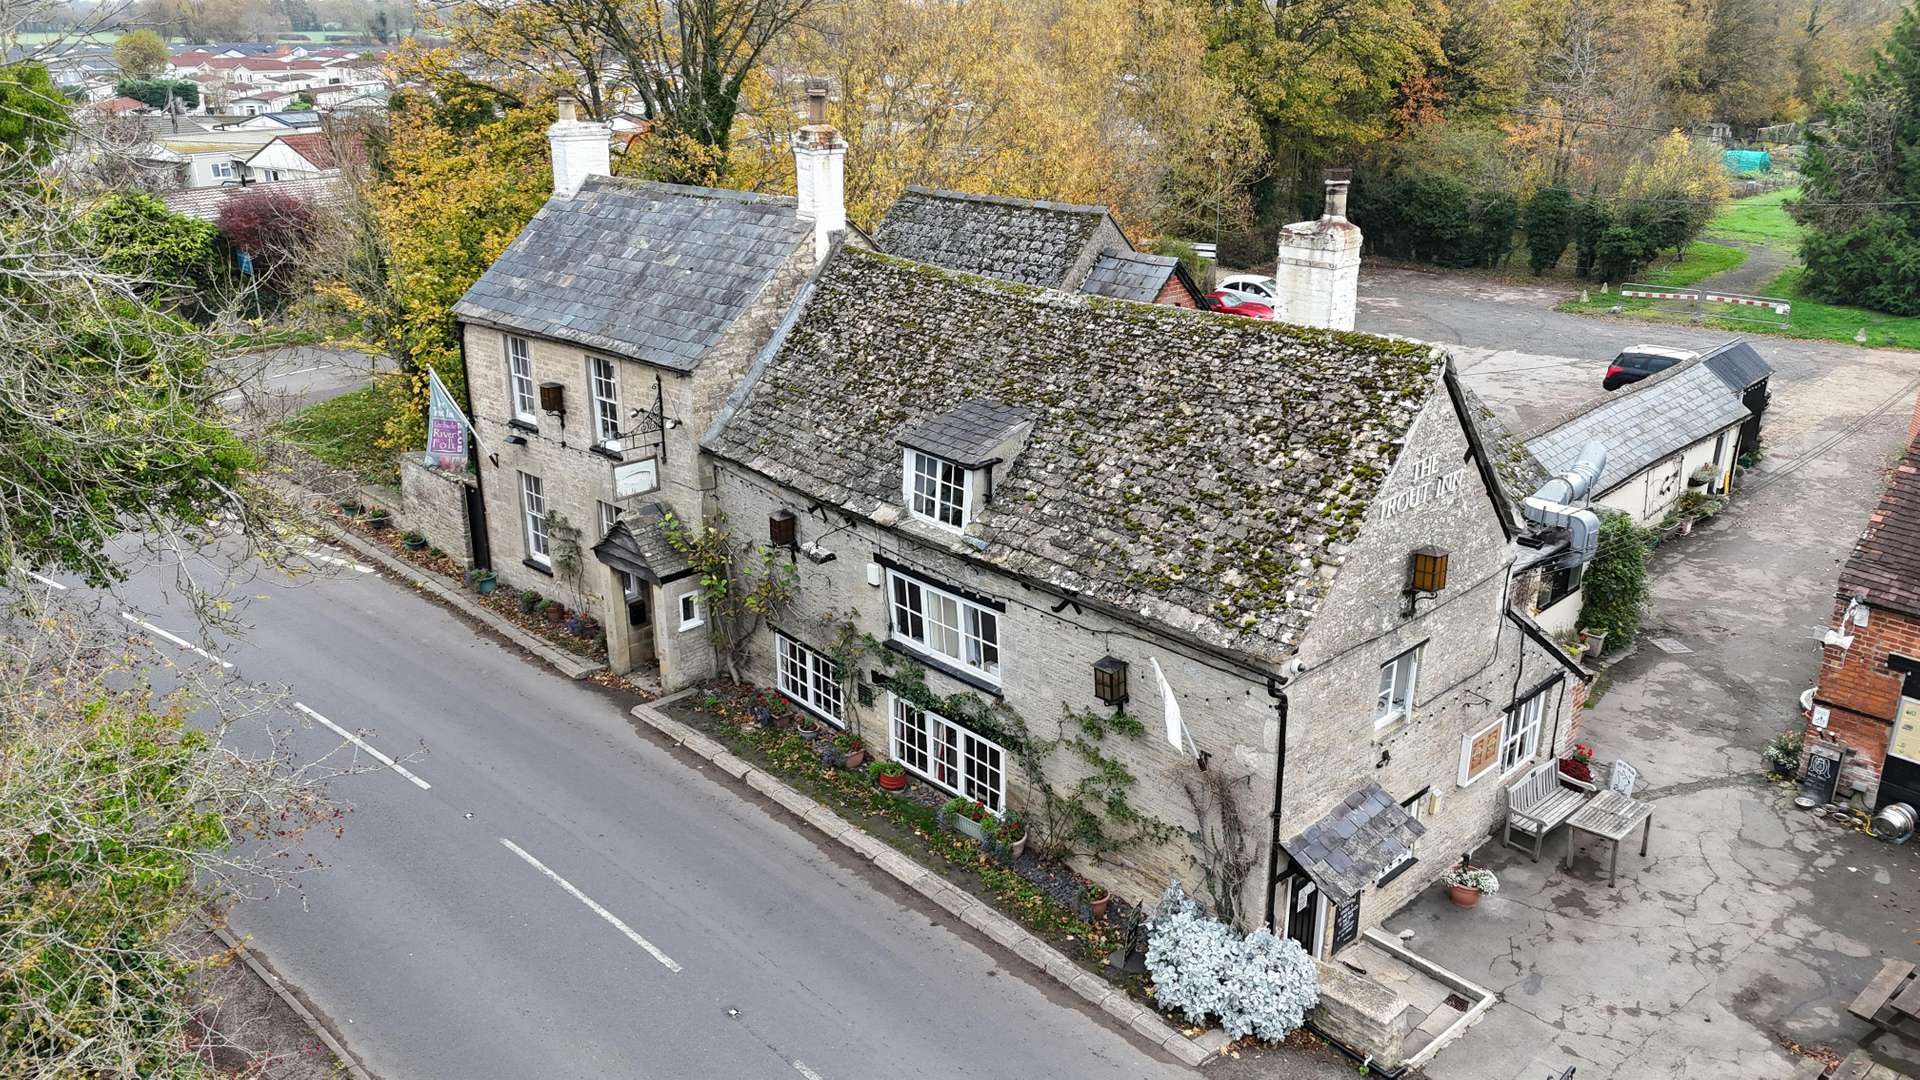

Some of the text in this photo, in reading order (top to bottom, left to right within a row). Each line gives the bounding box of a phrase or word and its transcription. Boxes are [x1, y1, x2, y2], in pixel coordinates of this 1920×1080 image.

[1412, 453, 1440, 484] THE
[1379, 467, 1465, 525] TROUT INN
